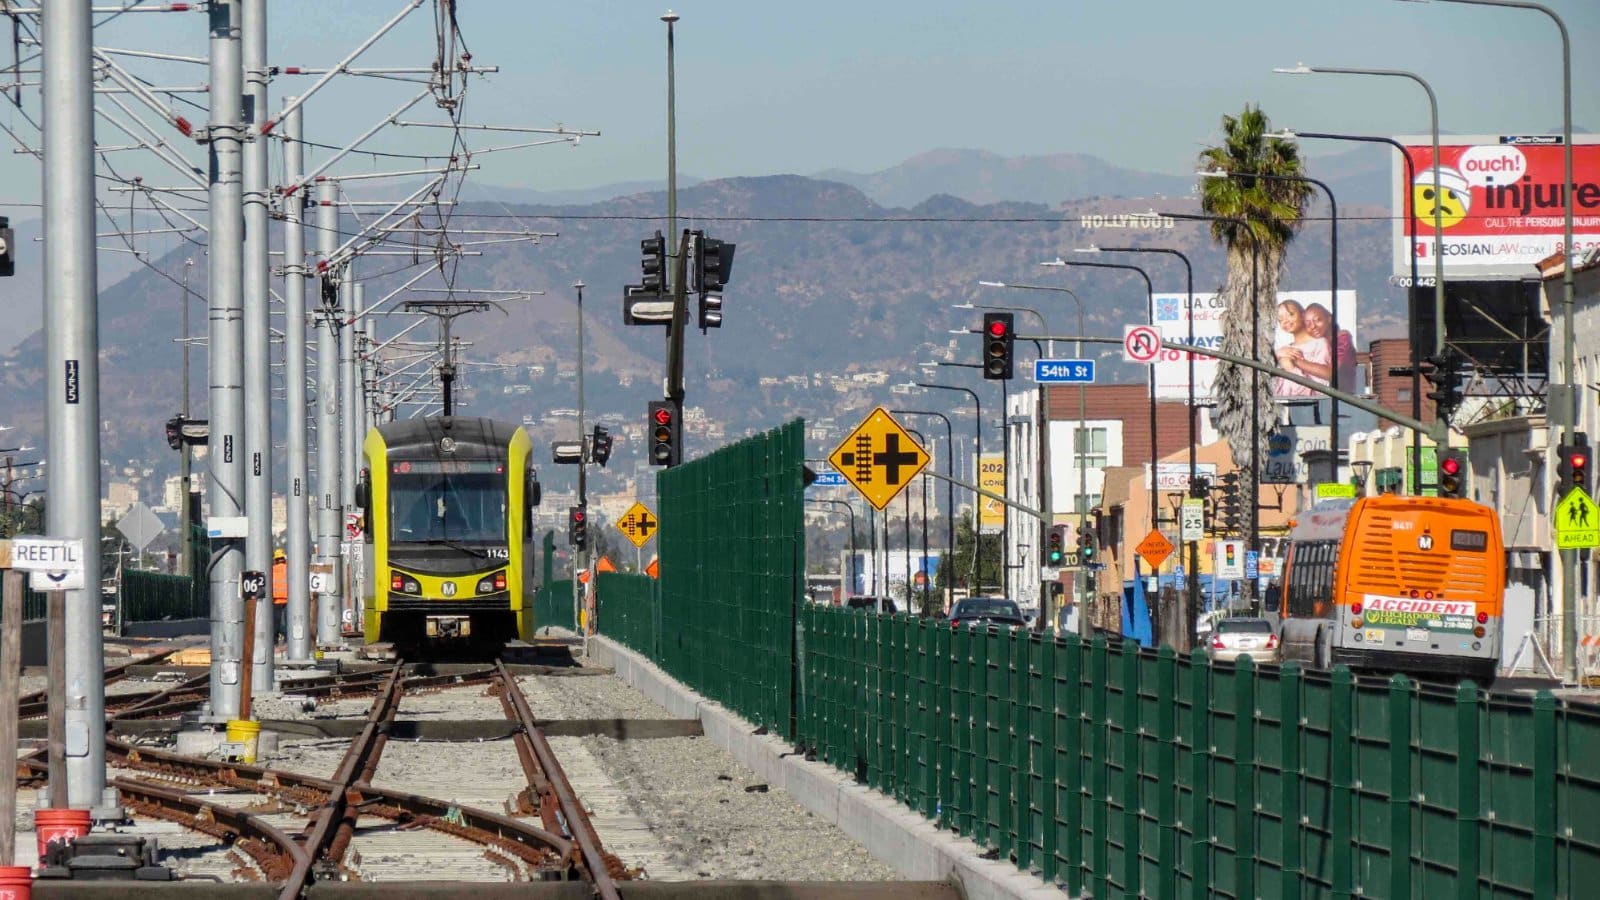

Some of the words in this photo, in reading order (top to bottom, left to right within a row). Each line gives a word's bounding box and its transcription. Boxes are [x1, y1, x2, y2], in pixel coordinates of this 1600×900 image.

[1466, 155, 1520, 171] ouch!
[1081, 214, 1174, 229] HOLLYWOOD
[1485, 219, 1505, 228] CALL
[1508, 219, 1524, 227] THE
[1525, 218, 1570, 227] PERSONA
[1041, 365, 1070, 377] 54th
[1075, 365, 1088, 377] St
[67, 361, 77, 401] 1255
[1296, 437, 1327, 452] Coin
[1184, 519, 1202, 529] 25
[1419, 537, 1432, 549] M
[1564, 534, 1594, 543] AHEAD
[486, 549, 509, 558] 1143
[442, 583, 455, 595] M
[1368, 599, 1473, 614] ACCIDENT
